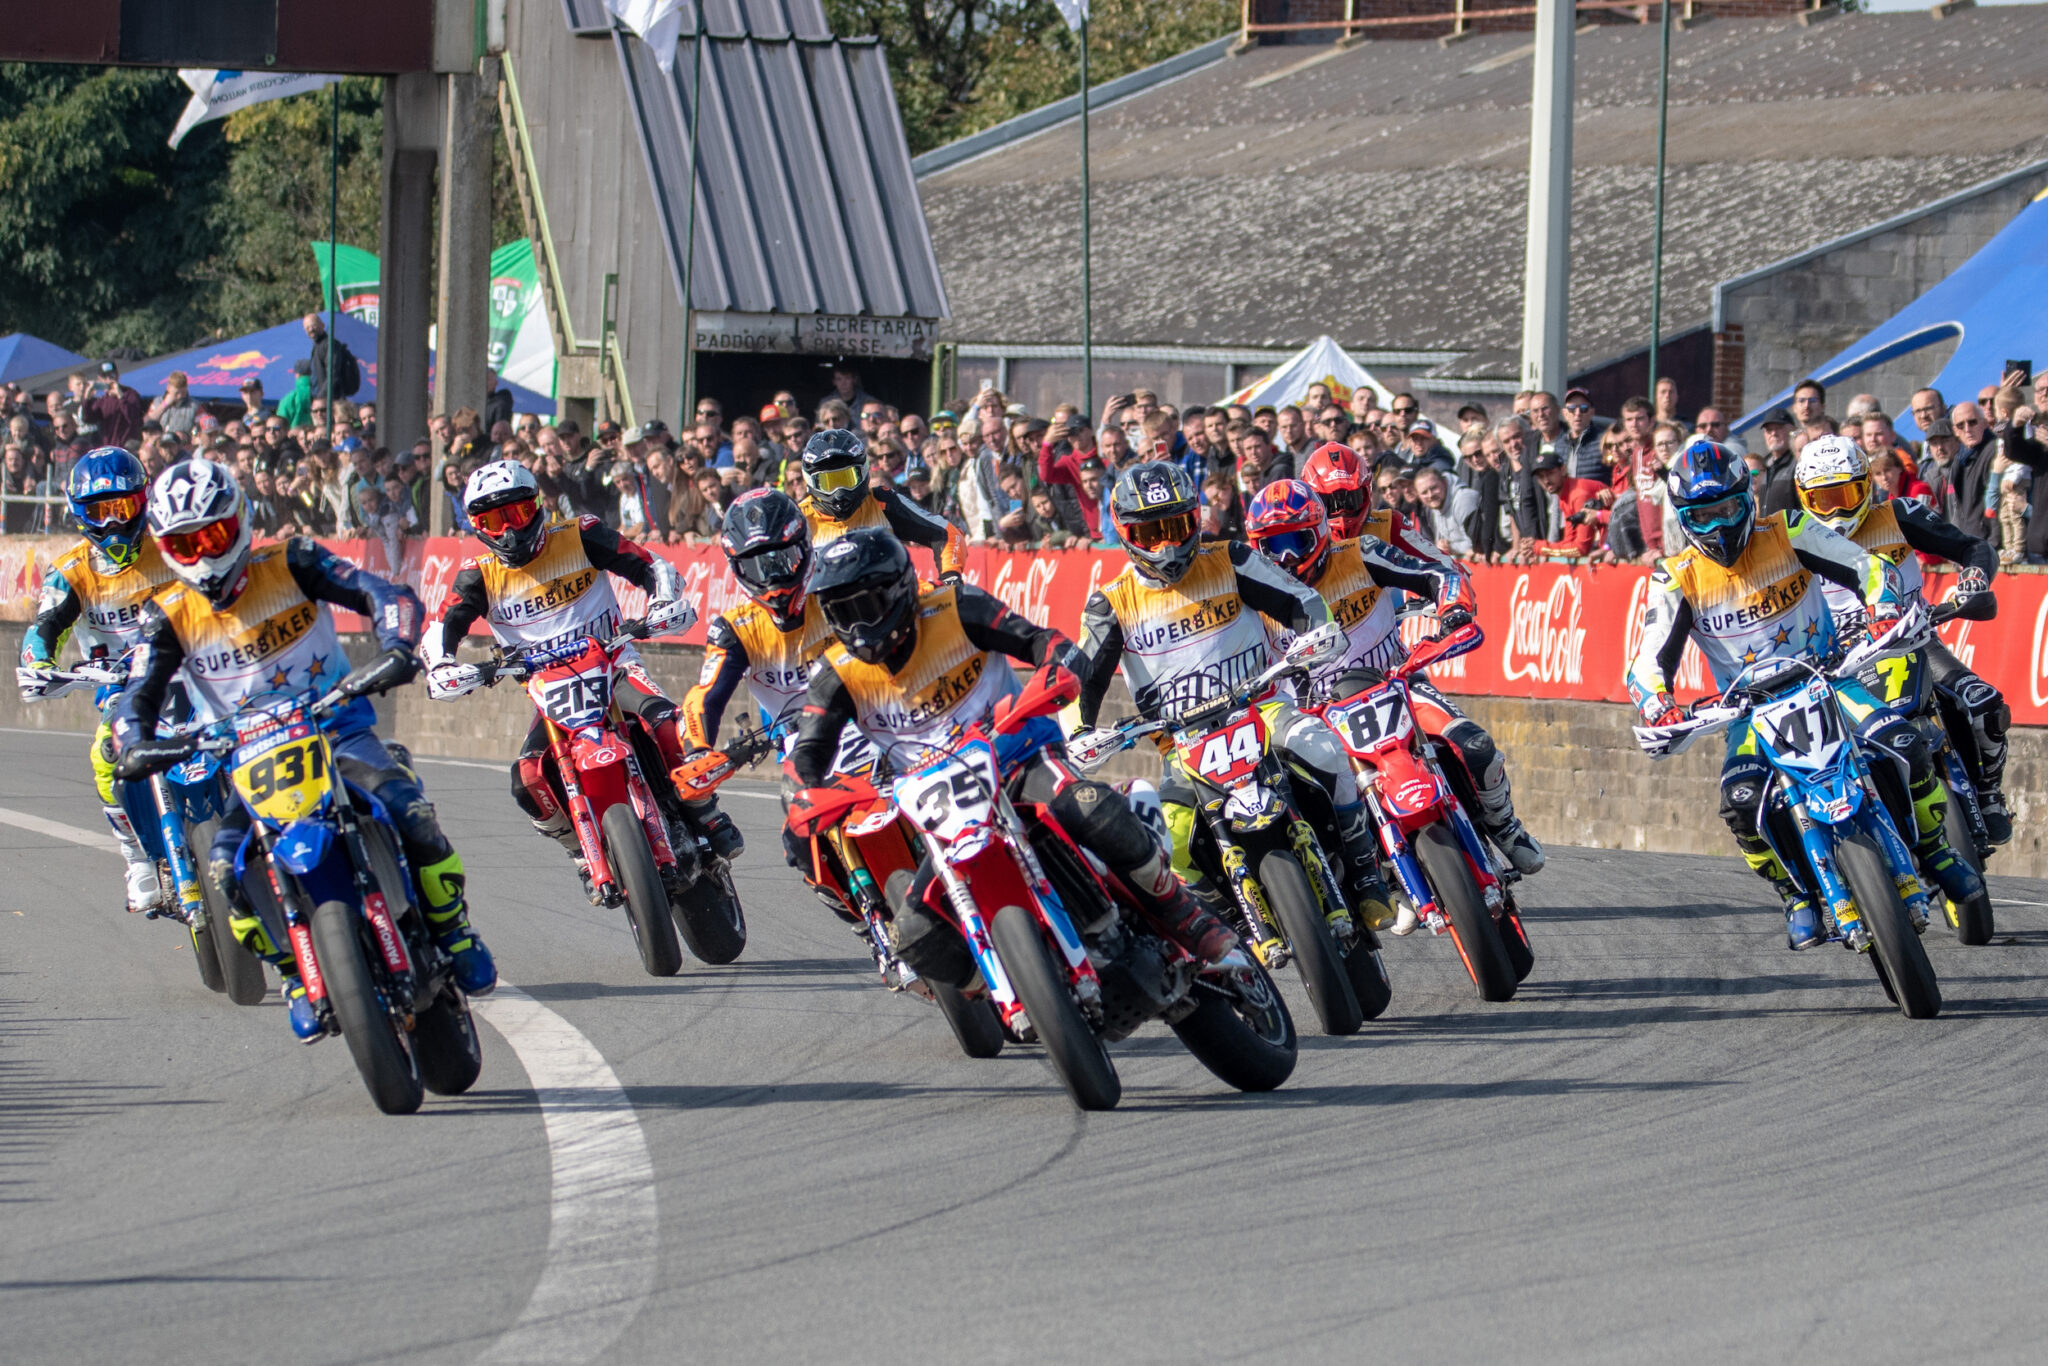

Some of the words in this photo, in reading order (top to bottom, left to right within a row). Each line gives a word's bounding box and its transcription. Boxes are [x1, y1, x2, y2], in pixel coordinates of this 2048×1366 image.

[696, 333, 777, 350] PADDOCK
[814, 337, 881, 354] PRESSE
[815, 317, 936, 336] SECRETARIAT
[502, 571, 594, 622] UPERBIKER
[1702, 574, 1808, 633] SUPERBIKER
[195, 605, 314, 675] SUPERBIKER
[875, 657, 983, 729] SUPERBIKER
[1875, 655, 1910, 703] 7
[1347, 693, 1403, 750] 87
[249, 740, 323, 806] 931
[1199, 722, 1262, 777] 44
[915, 761, 992, 832] 35
[372, 914, 401, 966] PANOLIN
[1233, 884, 1262, 942] DUNLOP
[297, 930, 319, 981] PANOLIN
